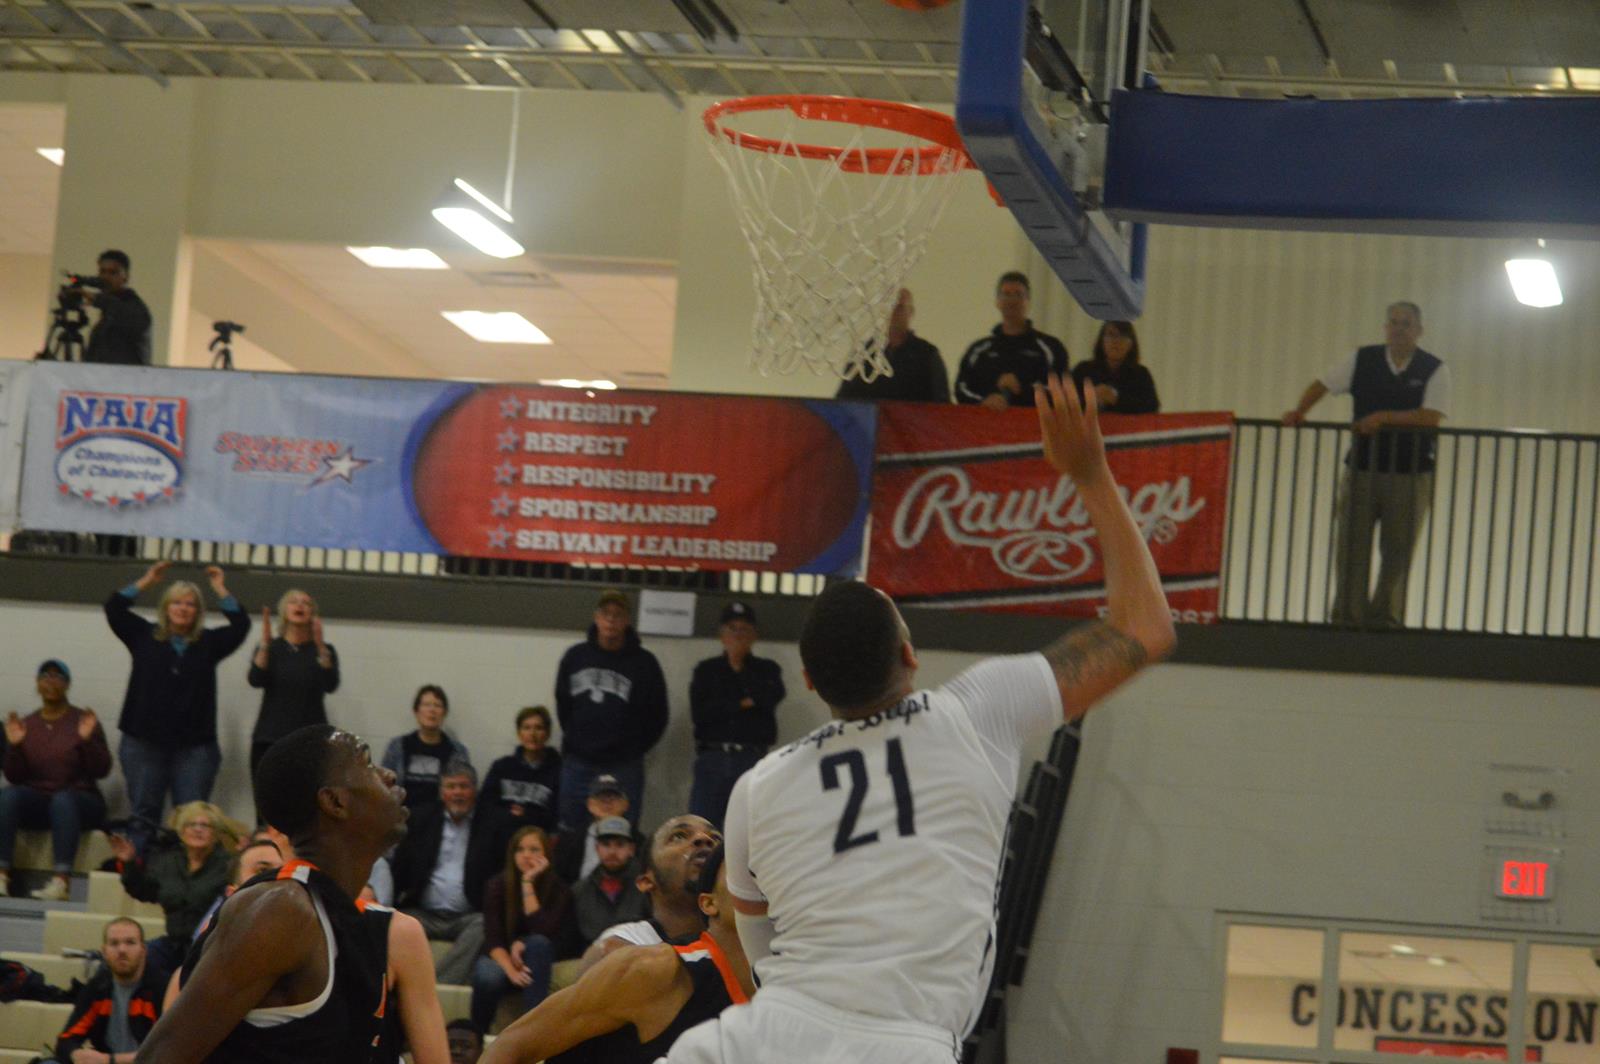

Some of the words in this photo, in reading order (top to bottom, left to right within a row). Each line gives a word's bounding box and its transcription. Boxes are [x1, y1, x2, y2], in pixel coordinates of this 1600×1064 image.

[62, 396, 179, 446] NAIA
[525, 399, 657, 426] INTEGRITY
[75, 447, 162, 467] Champions
[524, 431, 628, 456] RESPECT
[68, 464, 86, 478] of
[89, 464, 167, 482] Character
[521, 463, 717, 494] RESPONSIBILITY
[518, 496, 718, 526] SPORTSMANSHIP
[892, 465, 1205, 549] Rawligs
[515, 528, 628, 555] SERVANT
[631, 535, 778, 563] LEADERSHIP
[820, 736, 916, 854] 21
[1503, 860, 1549, 896] EXIT
[1290, 983, 1599, 1045] CNCESSON
